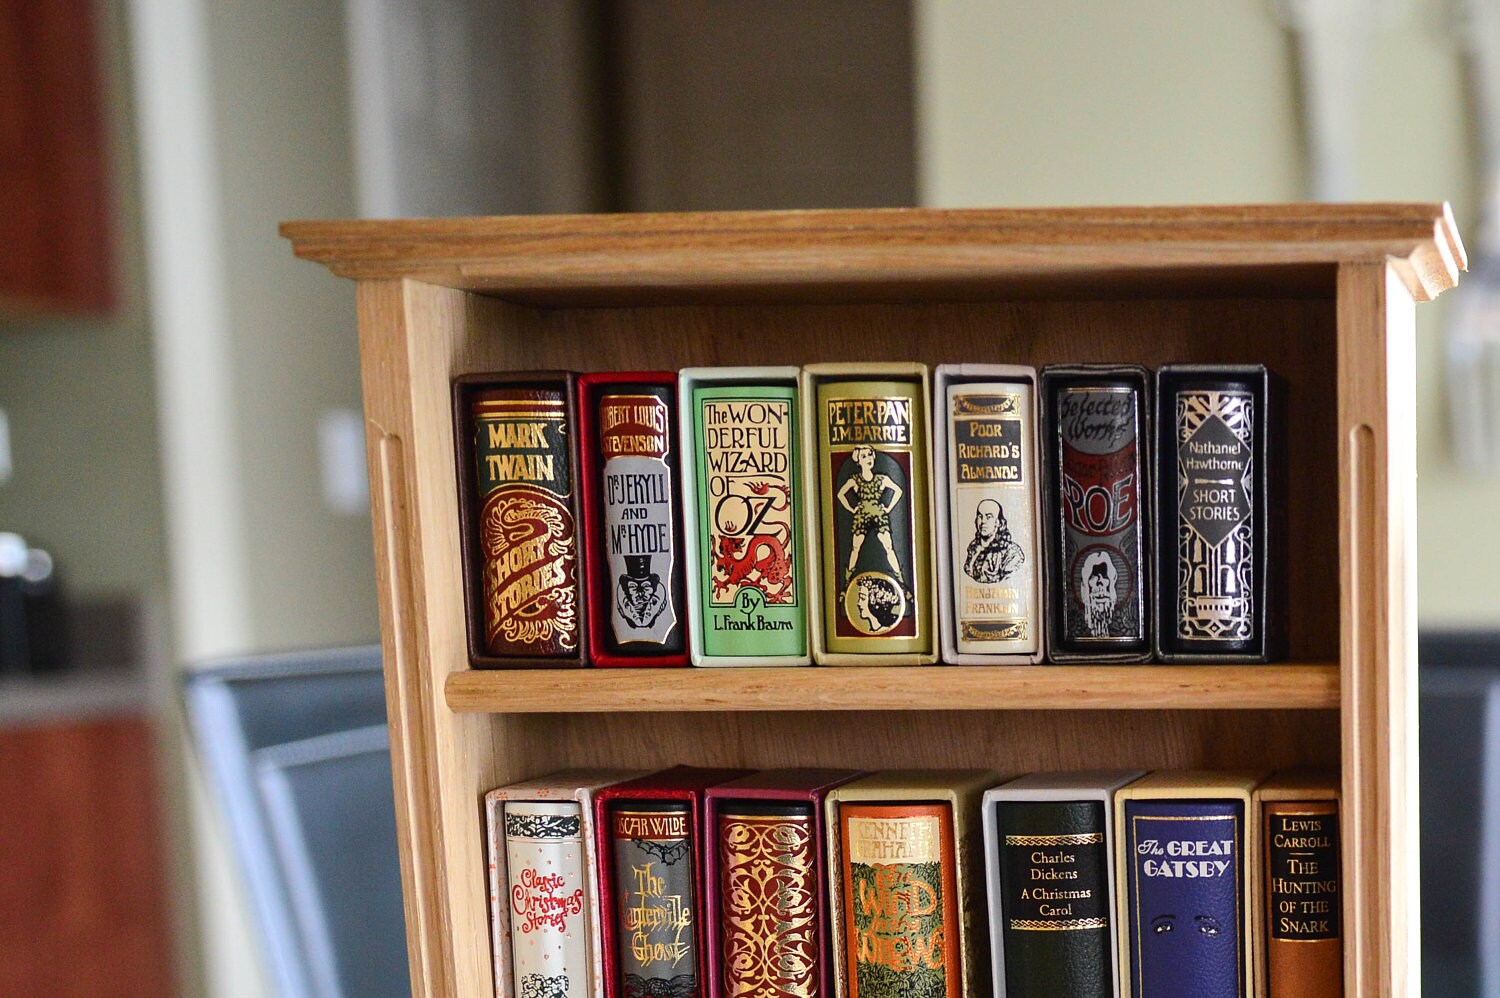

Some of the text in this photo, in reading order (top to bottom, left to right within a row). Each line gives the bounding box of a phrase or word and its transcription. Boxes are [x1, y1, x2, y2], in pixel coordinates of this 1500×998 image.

[634, 404, 664, 432] LOUIS
[707, 405, 727, 424] The
[489, 423, 548, 449] MARK
[708, 428, 785, 448] DERFUL
[970, 422, 1002, 438] POOR
[603, 435, 664, 453] STEVENSON
[959, 442, 1020, 459] RICHARD'S
[1189, 442, 1241, 454] Nathaniel
[486, 455, 554, 481] TWAIN
[708, 452, 787, 473] WIZARD
[1186, 457, 1244, 470] Hawthorne
[961, 464, 1018, 479] ALMANAC
[1065, 474, 1133, 532] POE
[1193, 489, 1236, 503] SHORT
[621, 508, 647, 520] AND
[715, 495, 781, 536] OZ
[1190, 506, 1240, 521] STORIES
[627, 525, 669, 553] HYDE
[486, 535, 546, 588] SHORT
[491, 560, 565, 627] STORIES
[742, 596, 759, 614] By
[724, 614, 755, 631] Frank
[757, 615, 793, 631] Baum
[650, 818, 688, 836] WILDE
[1282, 819, 1322, 831] LEWIS
[1138, 840, 1233, 856] The GREAT
[1274, 835, 1330, 848] CARROLL
[1031, 853, 1075, 864] Charles
[1287, 859, 1318, 875] THE
[1031, 869, 1077, 880] Dickens
[1144, 860, 1230, 878] GATSBY
[521, 869, 565, 892] Classic
[1273, 879, 1336, 894] HUNTING
[512, 884, 582, 914] Christmas
[1022, 888, 1091, 900] A Christmas
[1039, 905, 1072, 916] Carol
[1279, 901, 1329, 913] OF THE
[522, 911, 568, 933] Stories
[1280, 918, 1329, 933] SNARK
[631, 932, 690, 968] Ghost
